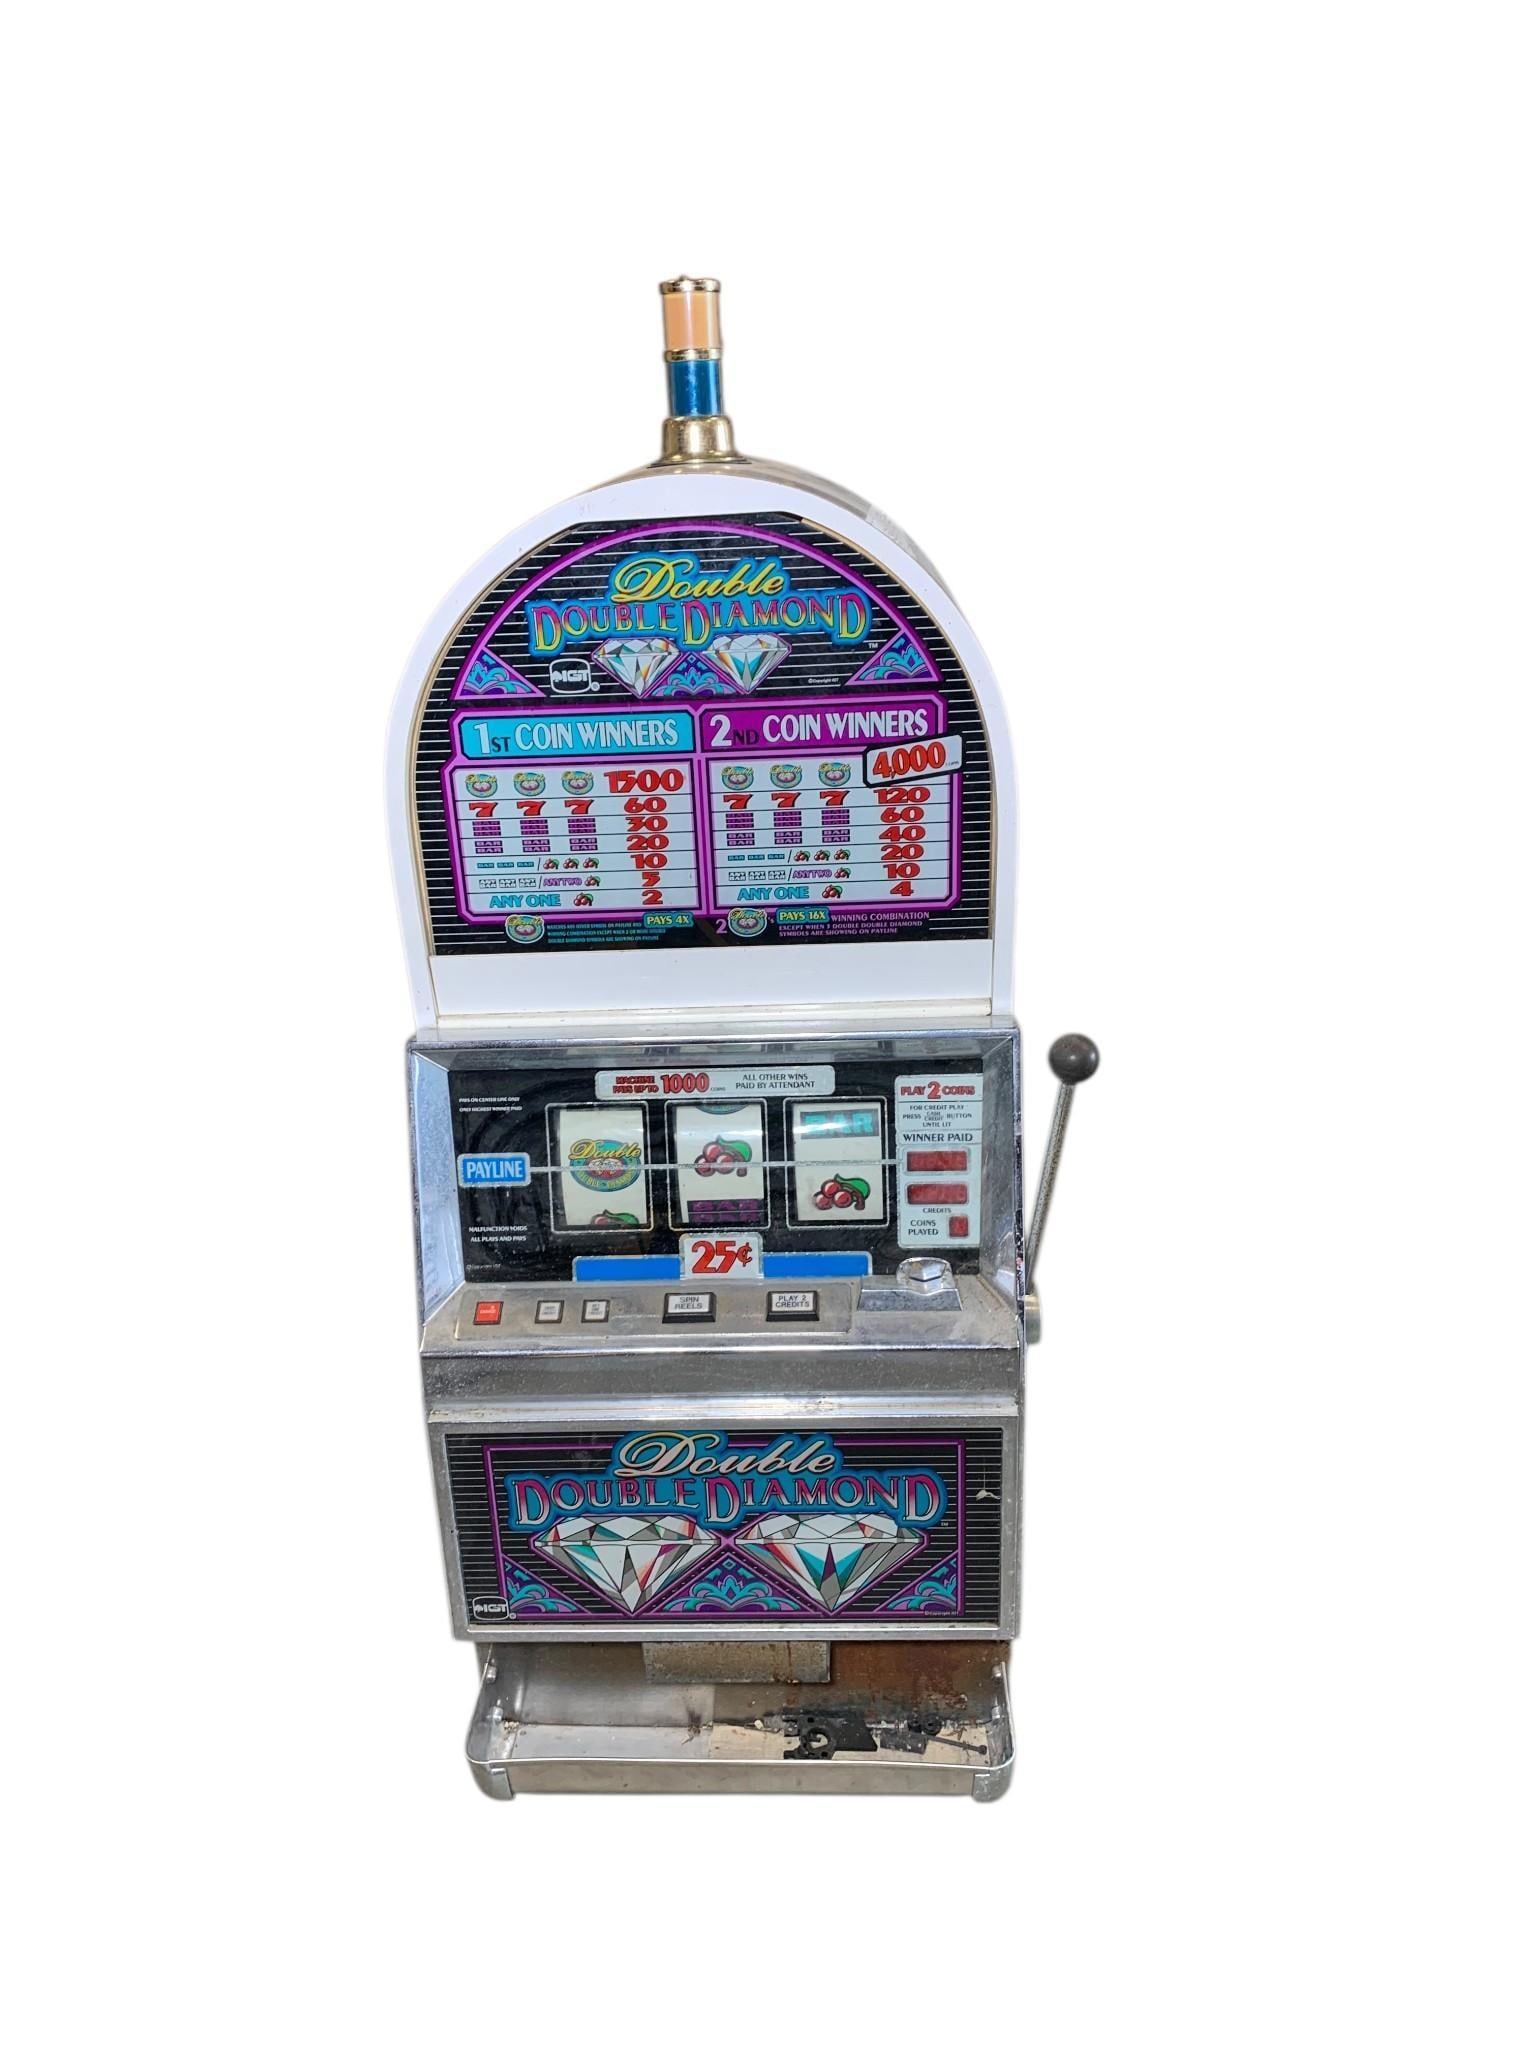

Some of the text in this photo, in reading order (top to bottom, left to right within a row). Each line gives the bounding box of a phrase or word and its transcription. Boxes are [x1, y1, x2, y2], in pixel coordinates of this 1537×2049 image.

[611, 557, 784, 602] Double
[532, 602, 679, 651] DOUBLE
[681, 594, 867, 646] DIAMOND
[562, 669, 588, 682] IGT
[515, 722, 574, 751] COIN
[576, 718, 679, 749] WINNERS
[762, 713, 821, 743] COIN
[825, 708, 929, 740] WINNERS
[872, 741, 946, 779] 4,000
[604, 768, 684, 794] 1500
[469, 796, 667, 818] 7 7 7 60
[723, 786, 931, 810] 7 7 7 120
[625, 815, 668, 832] 30
[880, 806, 925, 823] 60
[626, 834, 669, 851] 20
[879, 825, 926, 842] 40
[630, 852, 668, 869] 10
[880, 843, 924, 860] 20
[642, 871, 660, 887] 5
[883, 862, 920, 879] 10
[489, 889, 663, 908] ANY ONE 2
[737, 880, 914, 901] ANY ONE 4
[646, 915, 690, 925] PAYS 4X
[715, 918, 728, 935] 2
[779, 911, 806, 921] PAYS
[808, 910, 826, 920] 16X
[830, 913, 868, 922] WINNING
[869, 911, 930, 921] COMBINATION
[661, 1072, 710, 1094] 1000
[735, 1082, 755, 1090] PAID
[768, 1080, 816, 1089] ATTENDANT
[759, 1073, 786, 1081] OTHER
[787, 1072, 809, 1080] WINS
[900, 1081, 976, 1100] PLAY 2 COINS
[903, 1133, 973, 1142] WINNER PAID
[568, 1139, 641, 1160] Double
[467, 1159, 523, 1180] PAYLINE
[908, 1228, 939, 1236] PLAYED
[910, 1219, 937, 1227] COINS
[674, 1302, 703, 1310] REELS
[613, 1431, 837, 1478] Double
[512, 1475, 700, 1527] DOUBLE
[704, 1473, 940, 1525] DIAMOND
[483, 1603, 506, 1613] IGT
